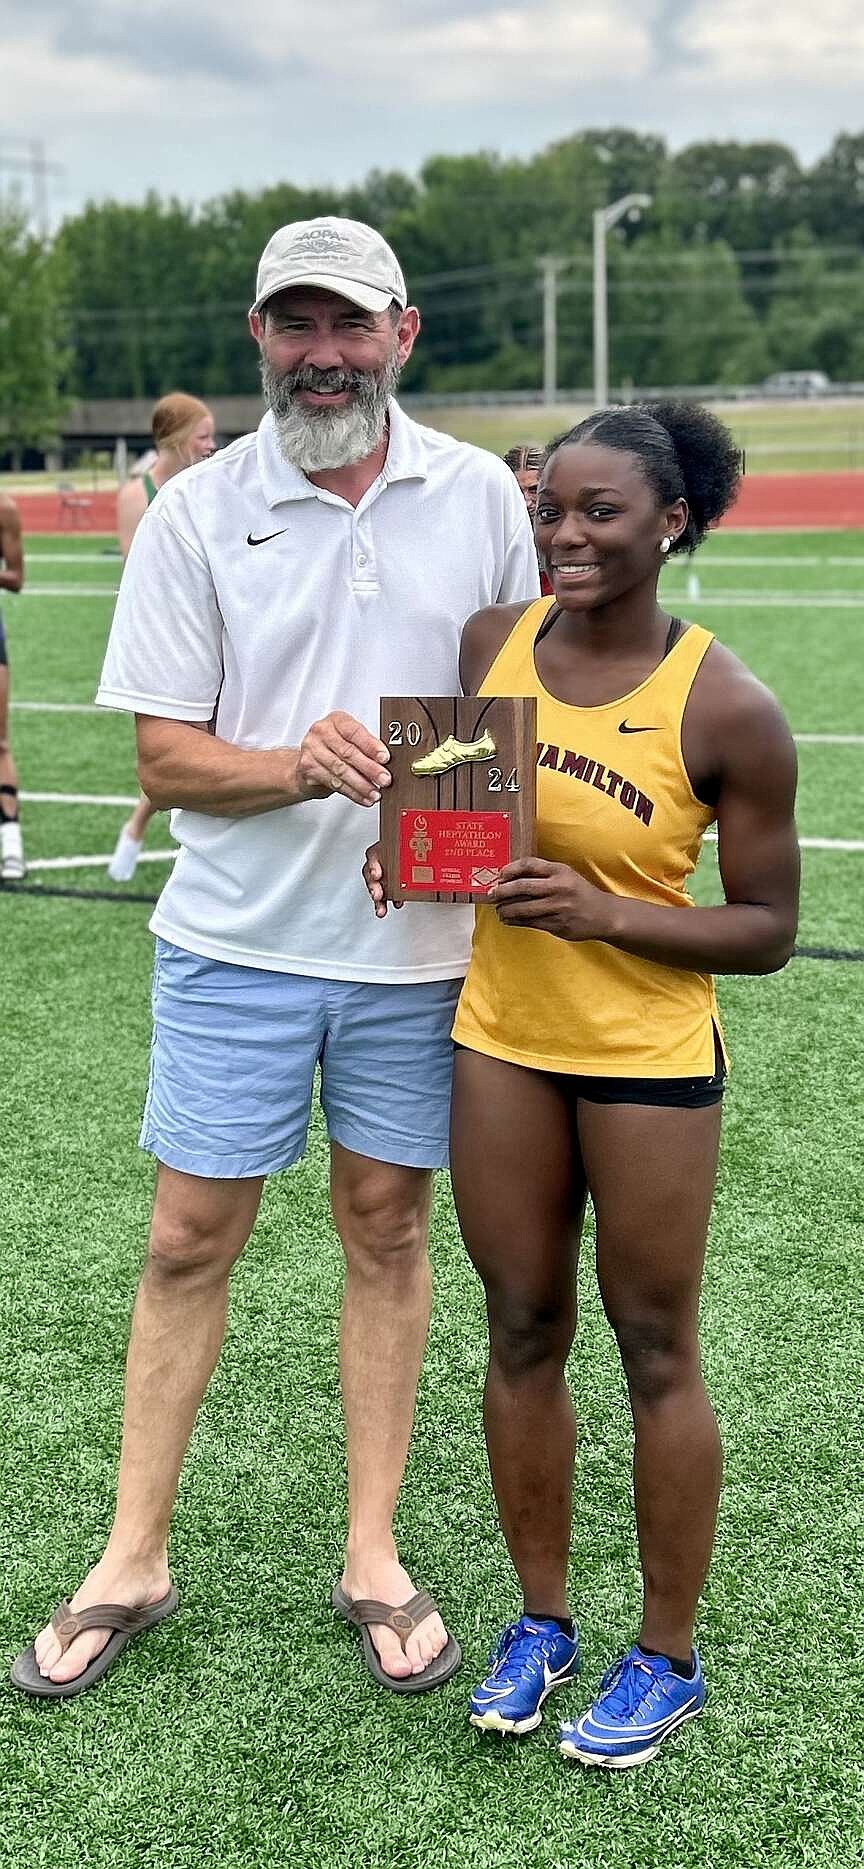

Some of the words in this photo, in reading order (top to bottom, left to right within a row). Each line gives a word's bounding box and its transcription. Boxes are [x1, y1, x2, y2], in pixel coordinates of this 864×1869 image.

[302, 229, 340, 241] AOPA
[388, 721, 422, 746] 20
[487, 767, 520, 792] 24
[456, 821, 485, 831] STATE
[438, 830, 504, 840] HEPTATHLON
[454, 839, 486, 848] AWARD
[466, 848, 496, 858] PLACE
